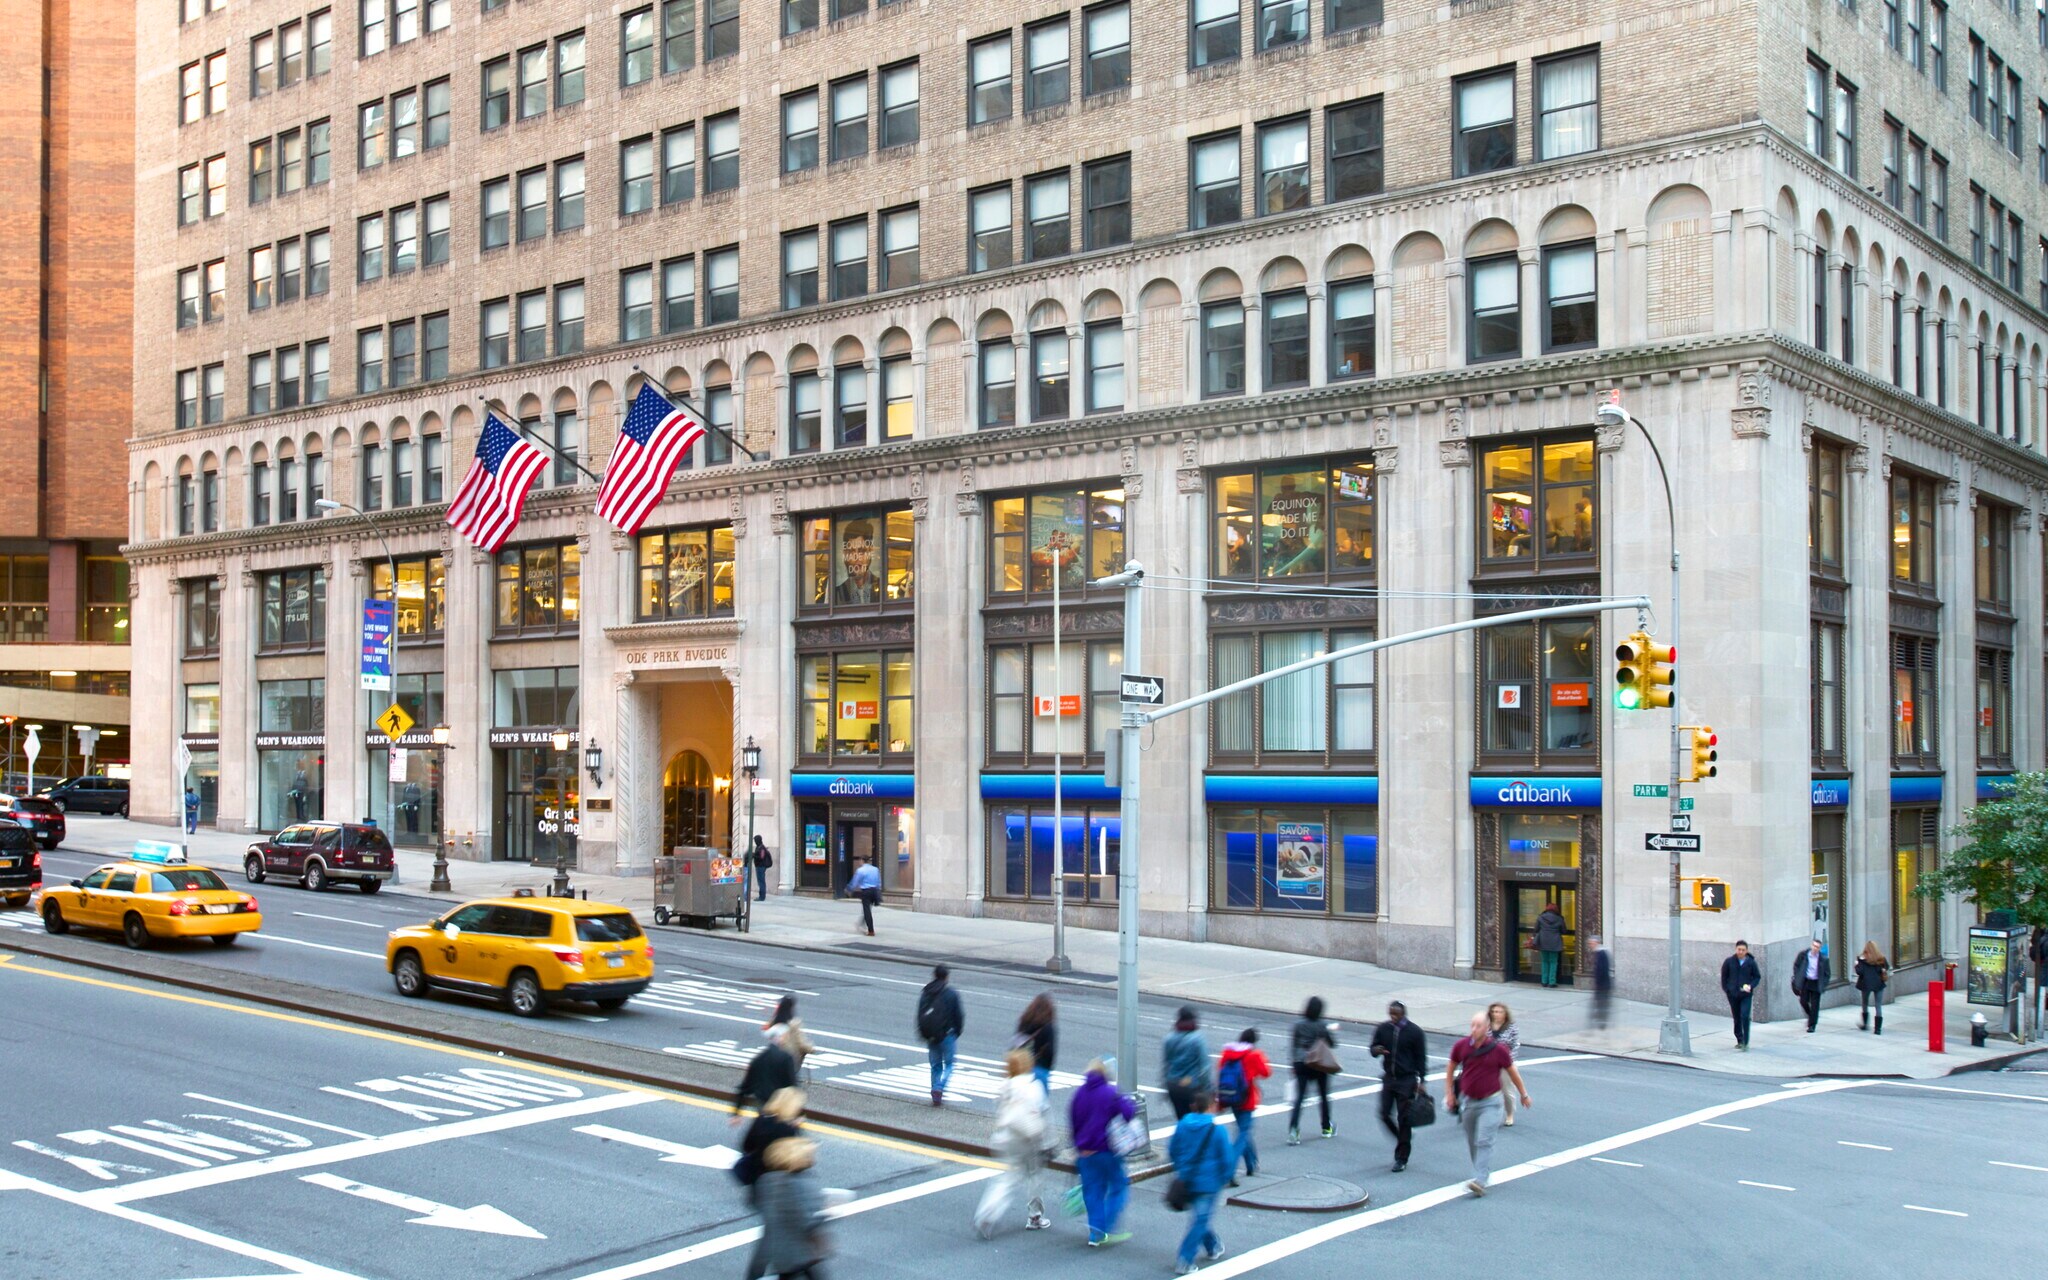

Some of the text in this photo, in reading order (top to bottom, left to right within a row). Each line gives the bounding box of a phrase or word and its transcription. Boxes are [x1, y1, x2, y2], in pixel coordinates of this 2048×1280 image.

[1272, 497, 1317, 511] EQUINOX
[1302, 512, 1317, 522] ME
[1280, 528, 1296, 538] DO
[848, 565, 859, 573] DO
[364, 632, 373, 640] YOU
[627, 648, 728, 664] ONE PARK AVENUE
[1125, 683, 1157, 696] ONE WAY
[257, 736, 279, 745] MEN'S
[491, 732, 519, 742] MEN'S
[829, 778, 874, 794] citibank
[1635, 786, 1657, 796] PARK
[1498, 782, 1572, 802] citibank
[1813, 784, 1839, 804] citibank
[538, 820, 580, 835] Opeing
[1279, 826, 1310, 835] SAVOR
[1530, 840, 1549, 849] ONE
[1653, 838, 1693, 847] ONE WAY
[1972, 945, 2006, 953] WAYRA
[320, 1068, 585, 1121] ONLY
